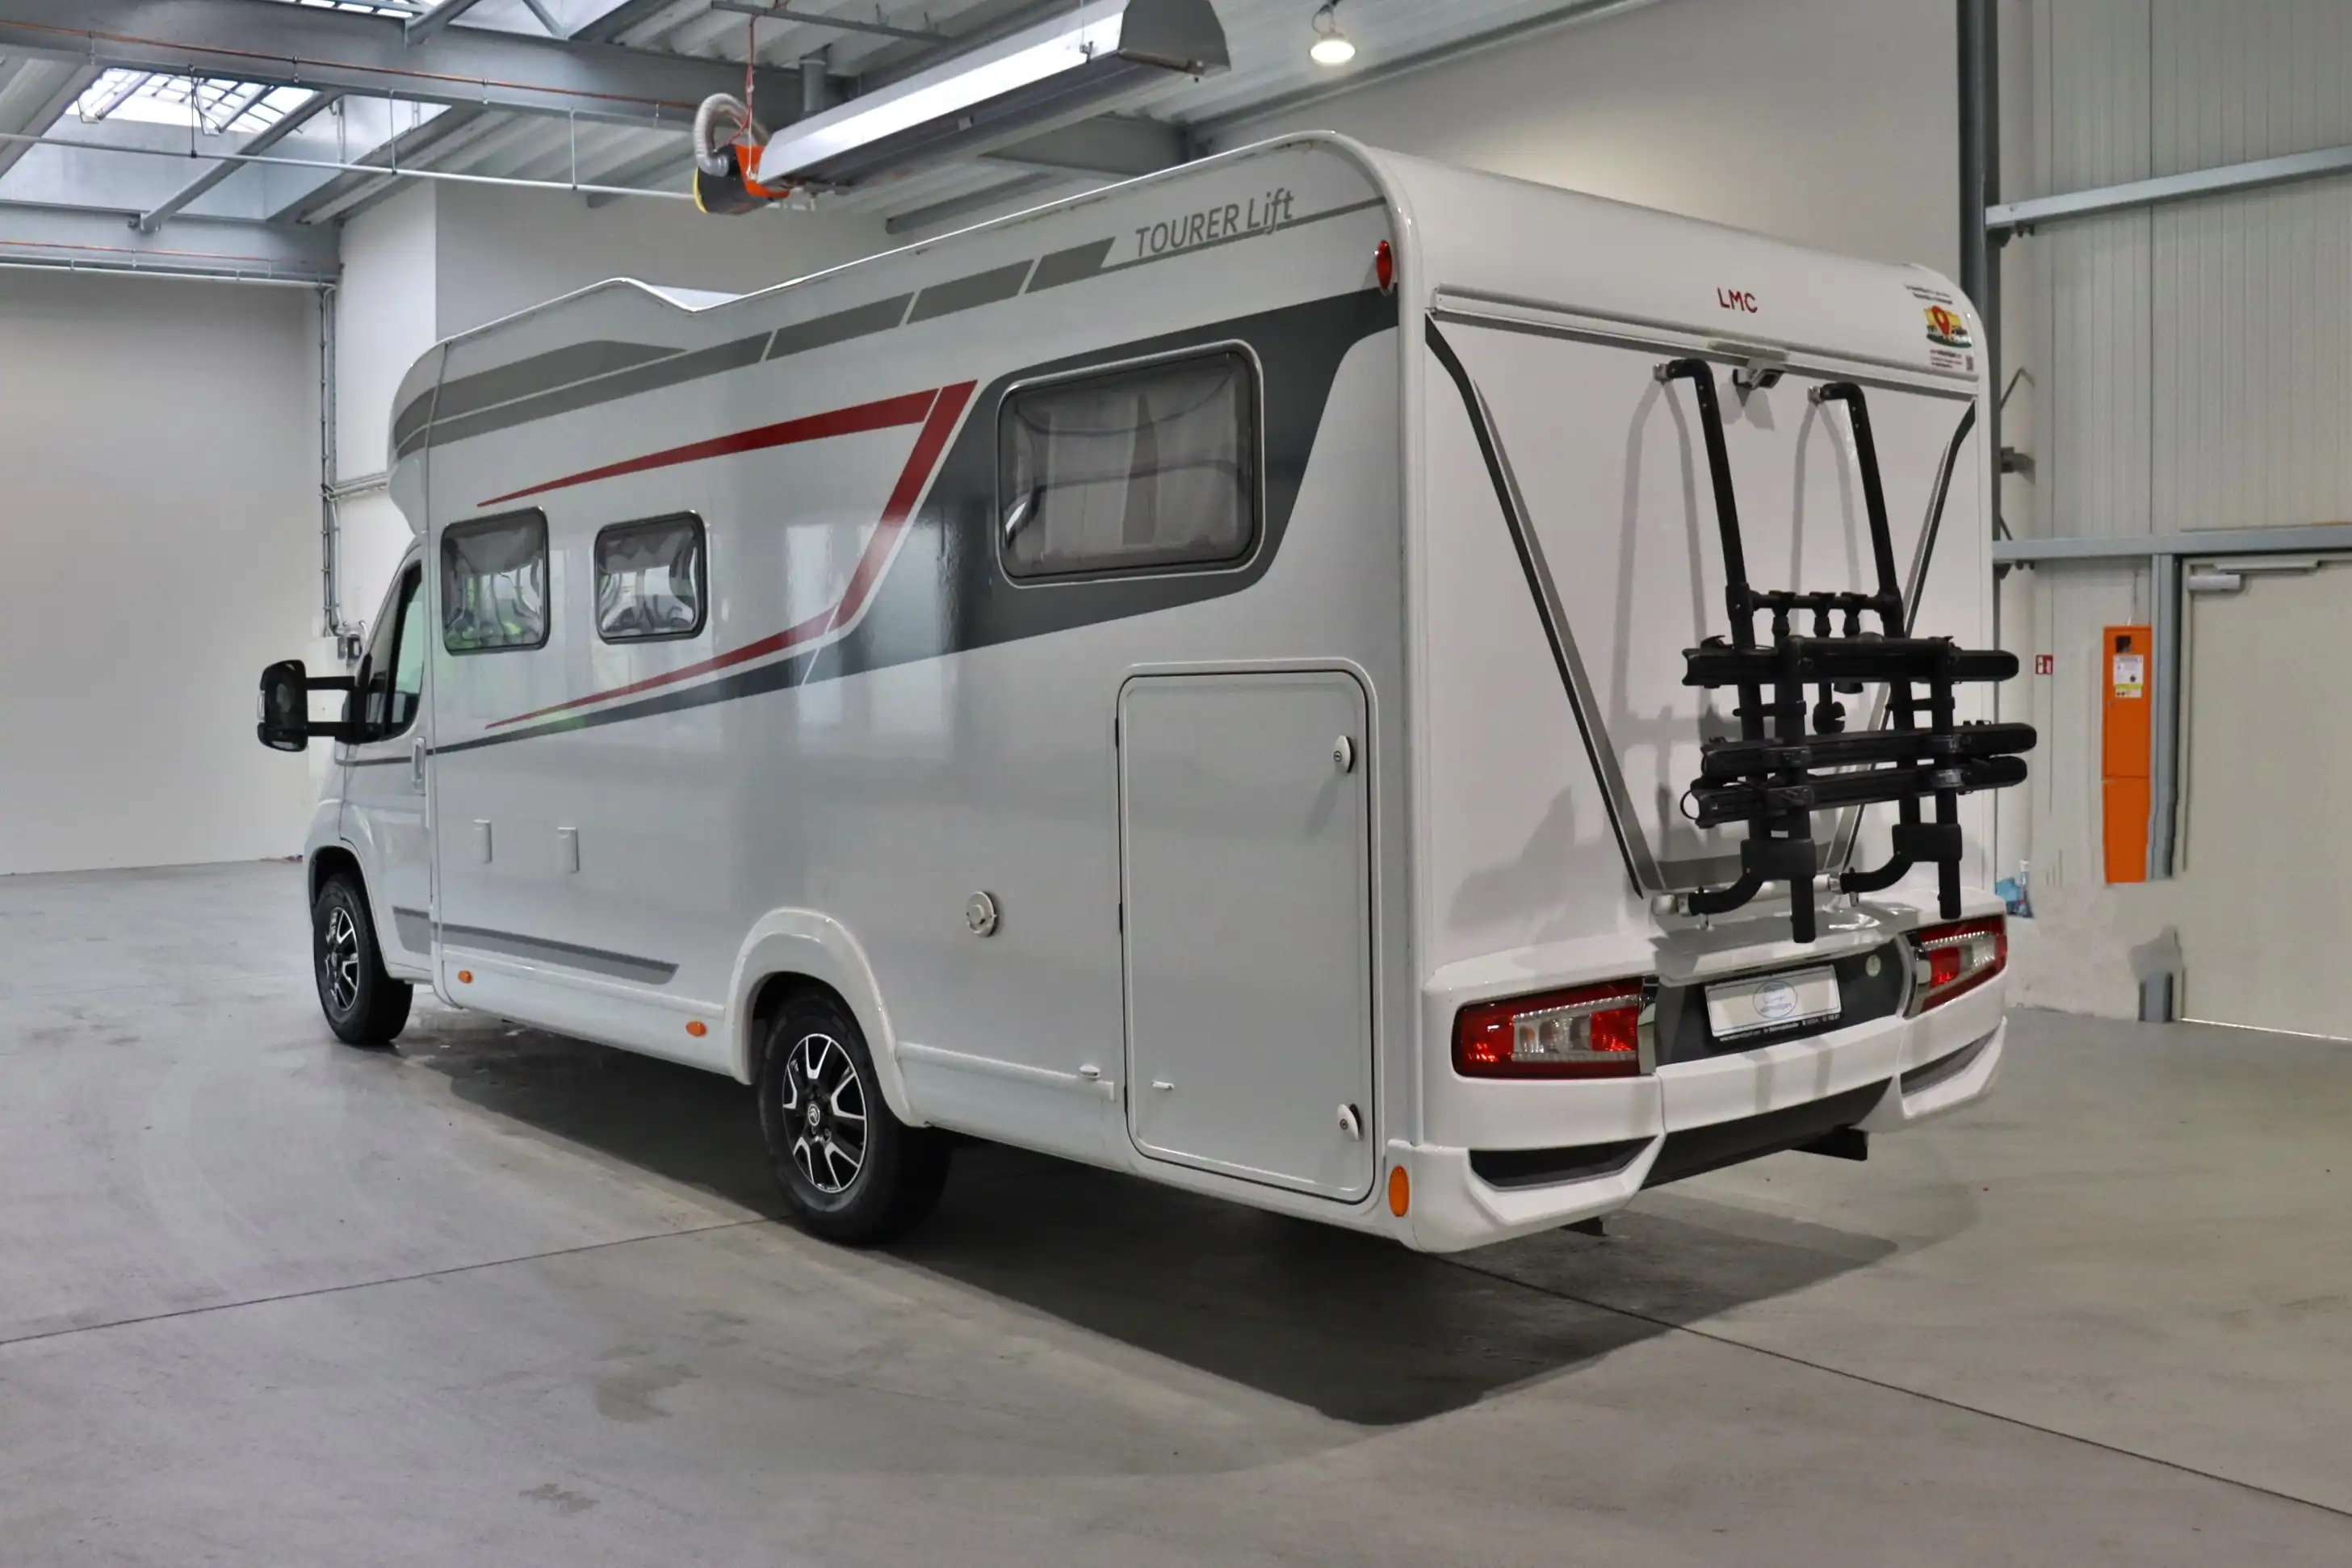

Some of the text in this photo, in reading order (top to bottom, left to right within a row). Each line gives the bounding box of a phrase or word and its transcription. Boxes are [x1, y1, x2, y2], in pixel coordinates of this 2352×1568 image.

[1135, 187, 1294, 258] TOURER Lift
[1717, 287, 1758, 313] LMC
